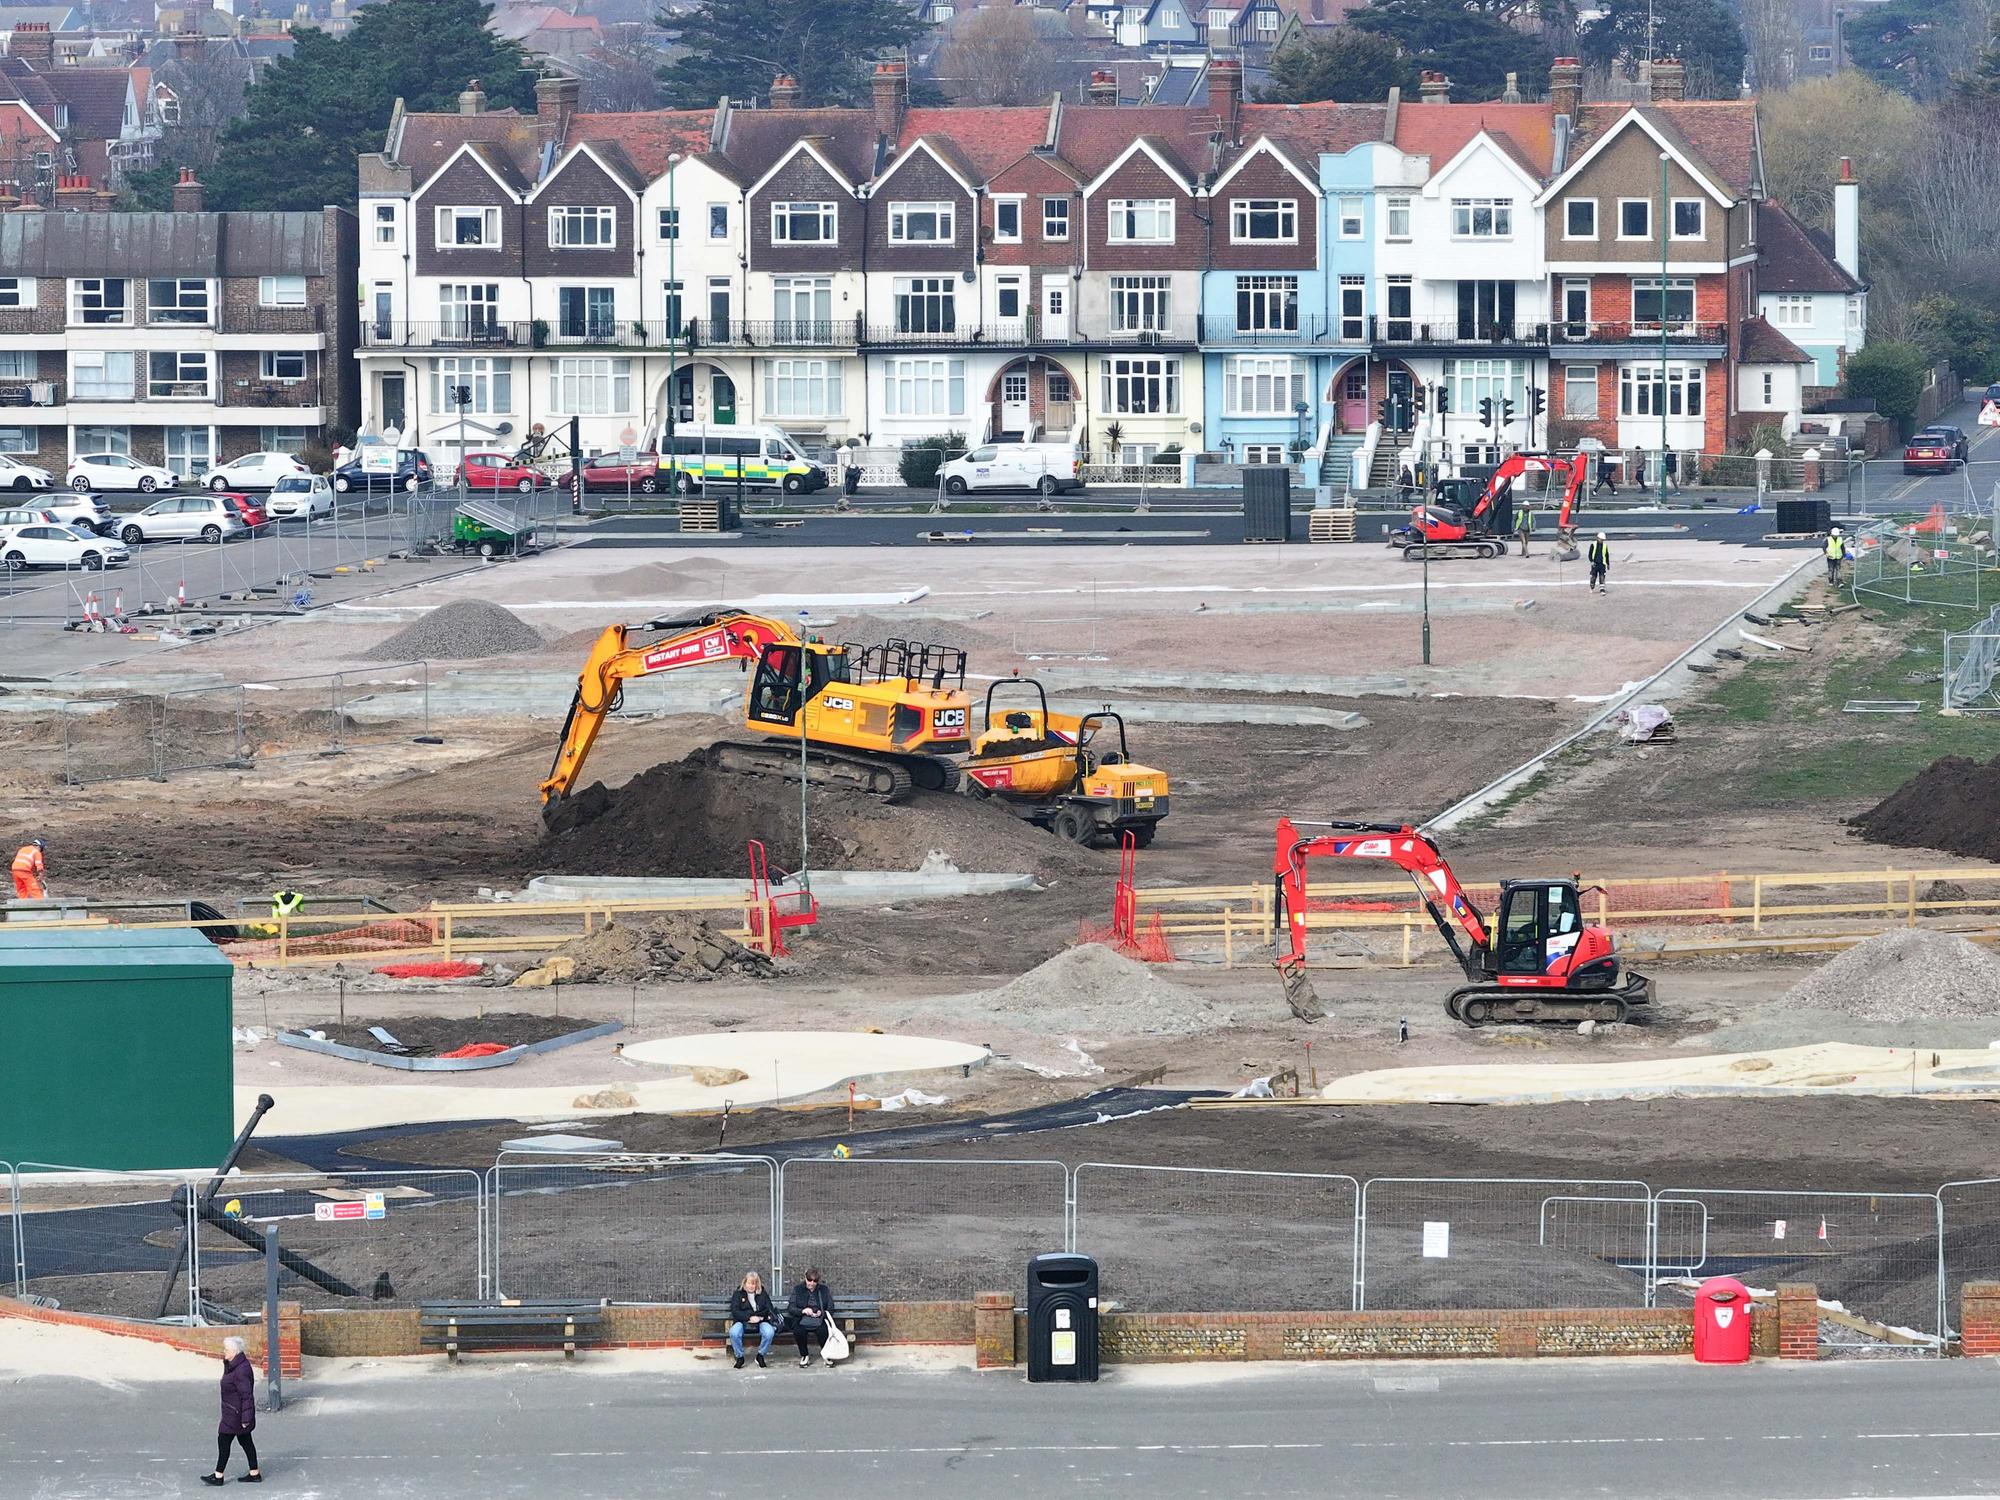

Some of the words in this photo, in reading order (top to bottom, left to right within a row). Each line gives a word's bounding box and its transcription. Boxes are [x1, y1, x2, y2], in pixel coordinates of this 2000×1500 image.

[648, 649, 681, 664] INSTANT
[681, 643, 700, 655] HIRE
[823, 696, 854, 711] JCB
[934, 709, 965, 726] JCB
